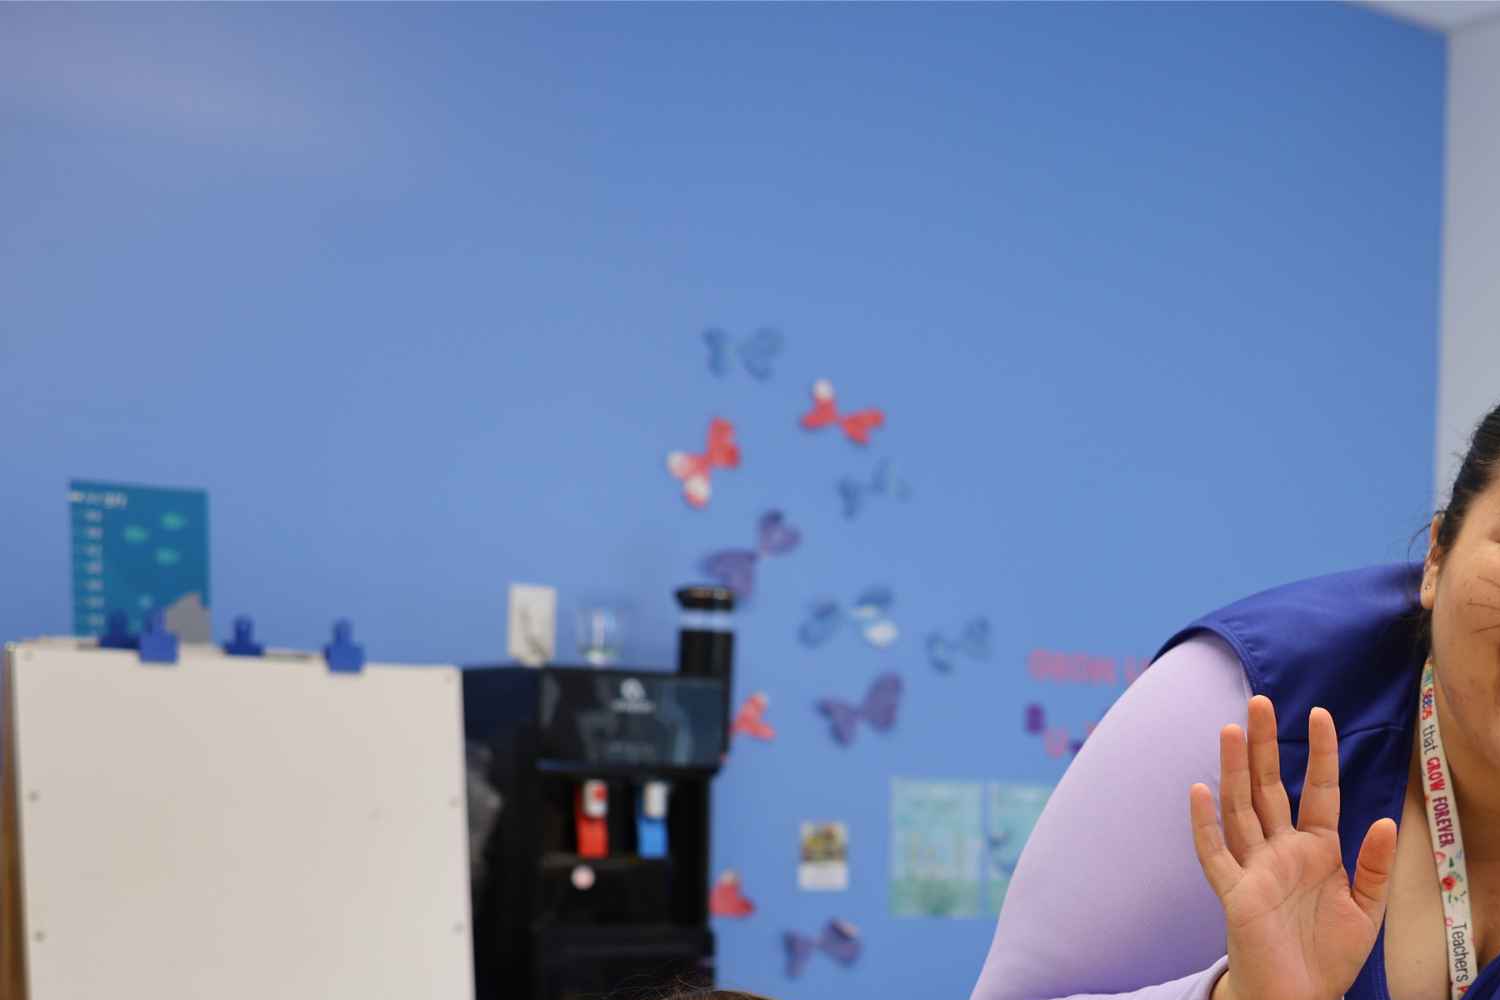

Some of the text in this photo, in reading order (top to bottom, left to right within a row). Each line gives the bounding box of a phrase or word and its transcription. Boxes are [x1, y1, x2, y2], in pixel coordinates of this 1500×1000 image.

[1422, 723, 1436, 755] that
[1426, 757, 1446, 791] GROW
[1432, 796, 1455, 848] FOREVER
[1451, 923, 1469, 982] Teachers
